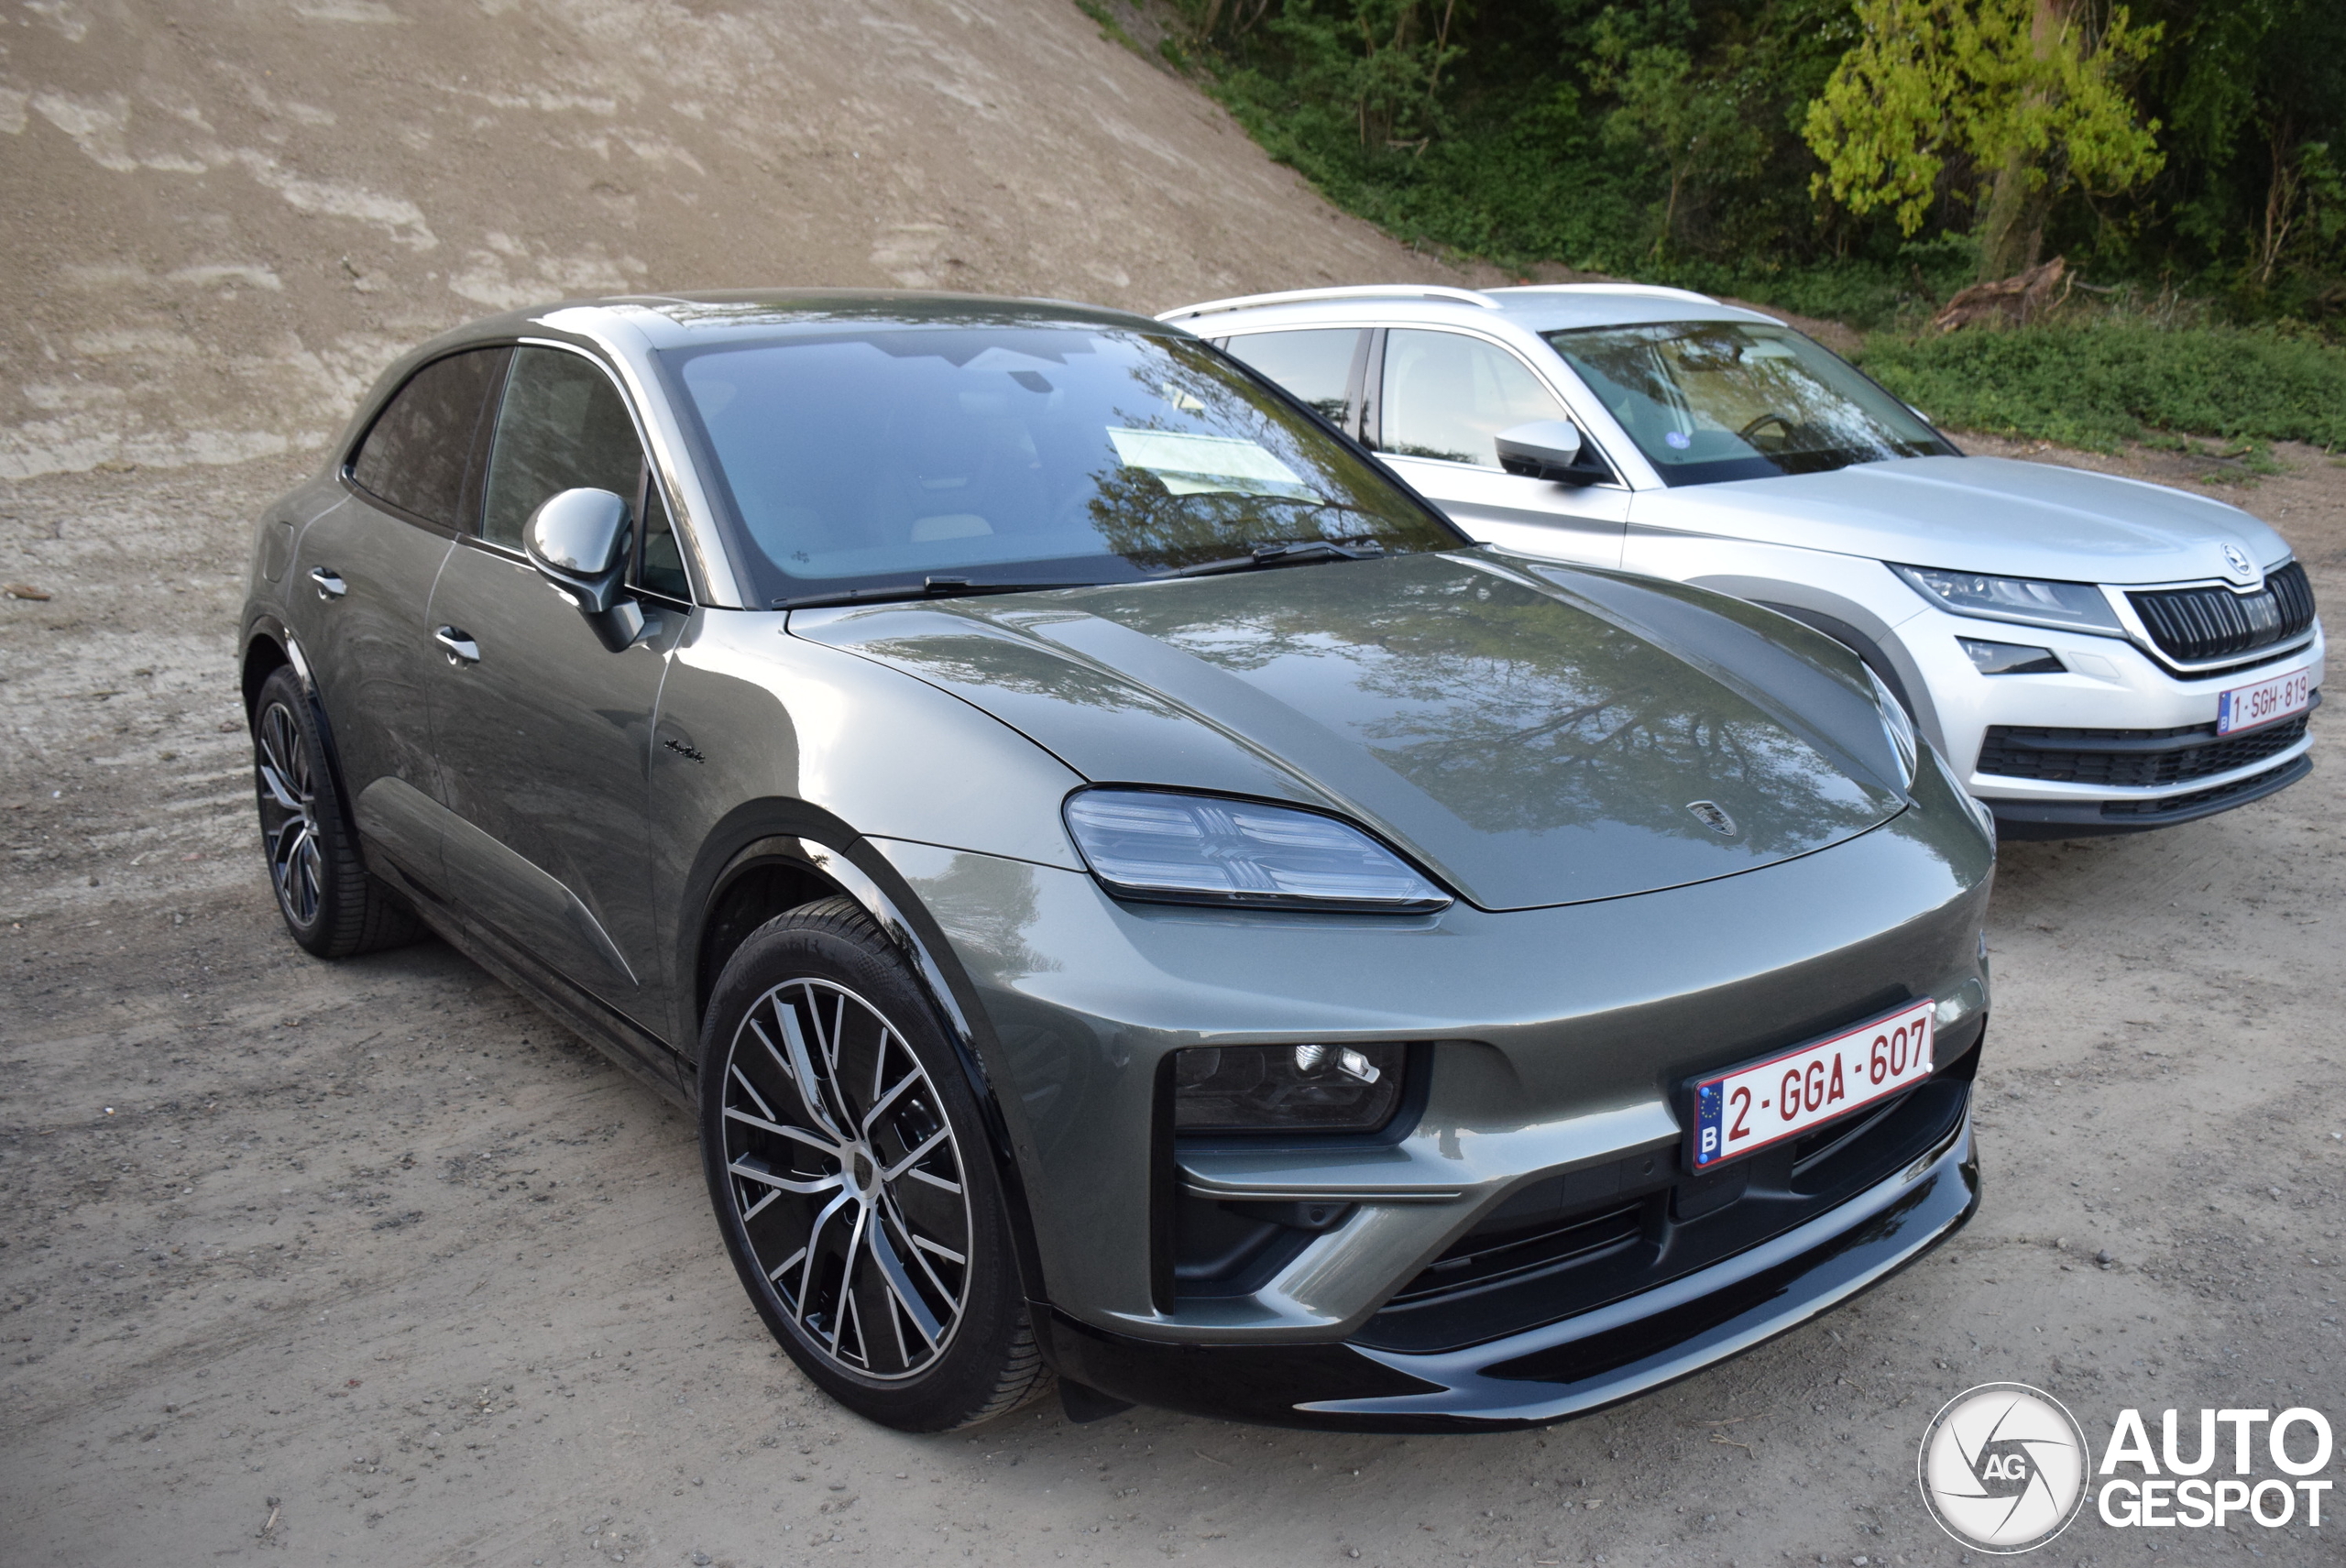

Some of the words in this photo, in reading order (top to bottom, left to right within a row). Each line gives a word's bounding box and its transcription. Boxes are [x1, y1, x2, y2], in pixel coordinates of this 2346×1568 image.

[2234, 676, 2308, 723] 1-SGH-819
[2220, 717, 2228, 729] B
[1728, 1016, 1926, 1142] 2-GGA-607
[1702, 1126, 1717, 1153] B
